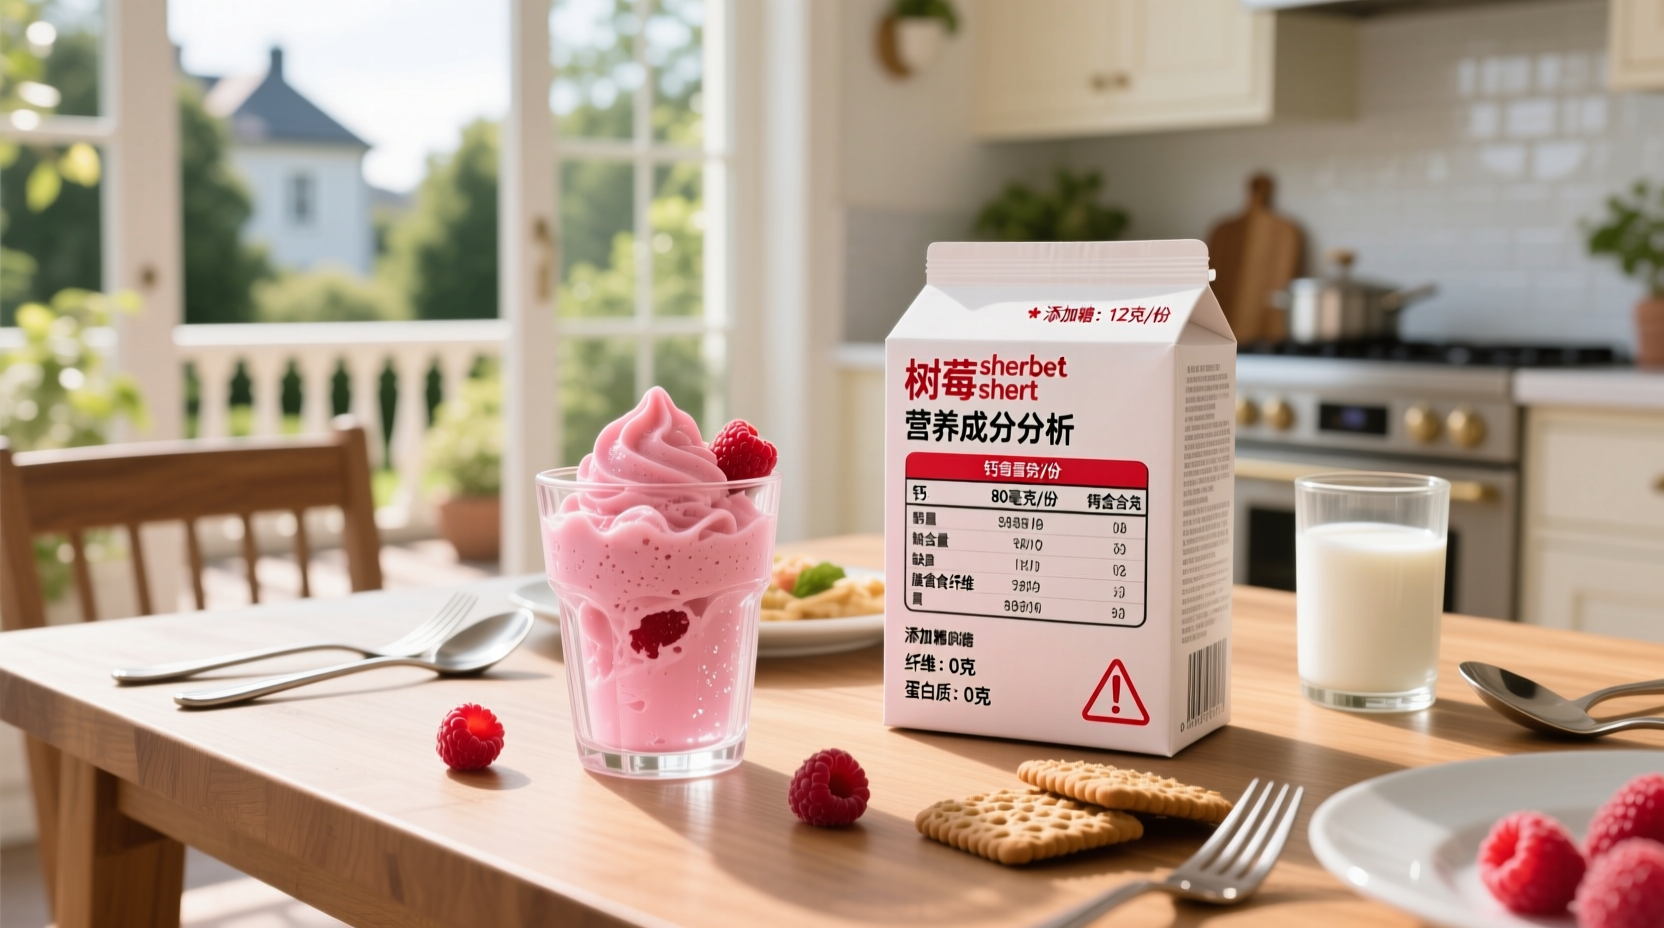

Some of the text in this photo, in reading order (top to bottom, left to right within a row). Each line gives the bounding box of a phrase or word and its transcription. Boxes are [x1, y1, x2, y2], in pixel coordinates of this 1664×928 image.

[904, 353, 1068, 402] 树莓 sherbet
[978, 379, 1039, 401] shert
[905, 408, 1075, 446] 营养成分分析
[904, 653, 976, 676] 纤维：0克
[904, 680, 991, 706] 蛋白质：0克
